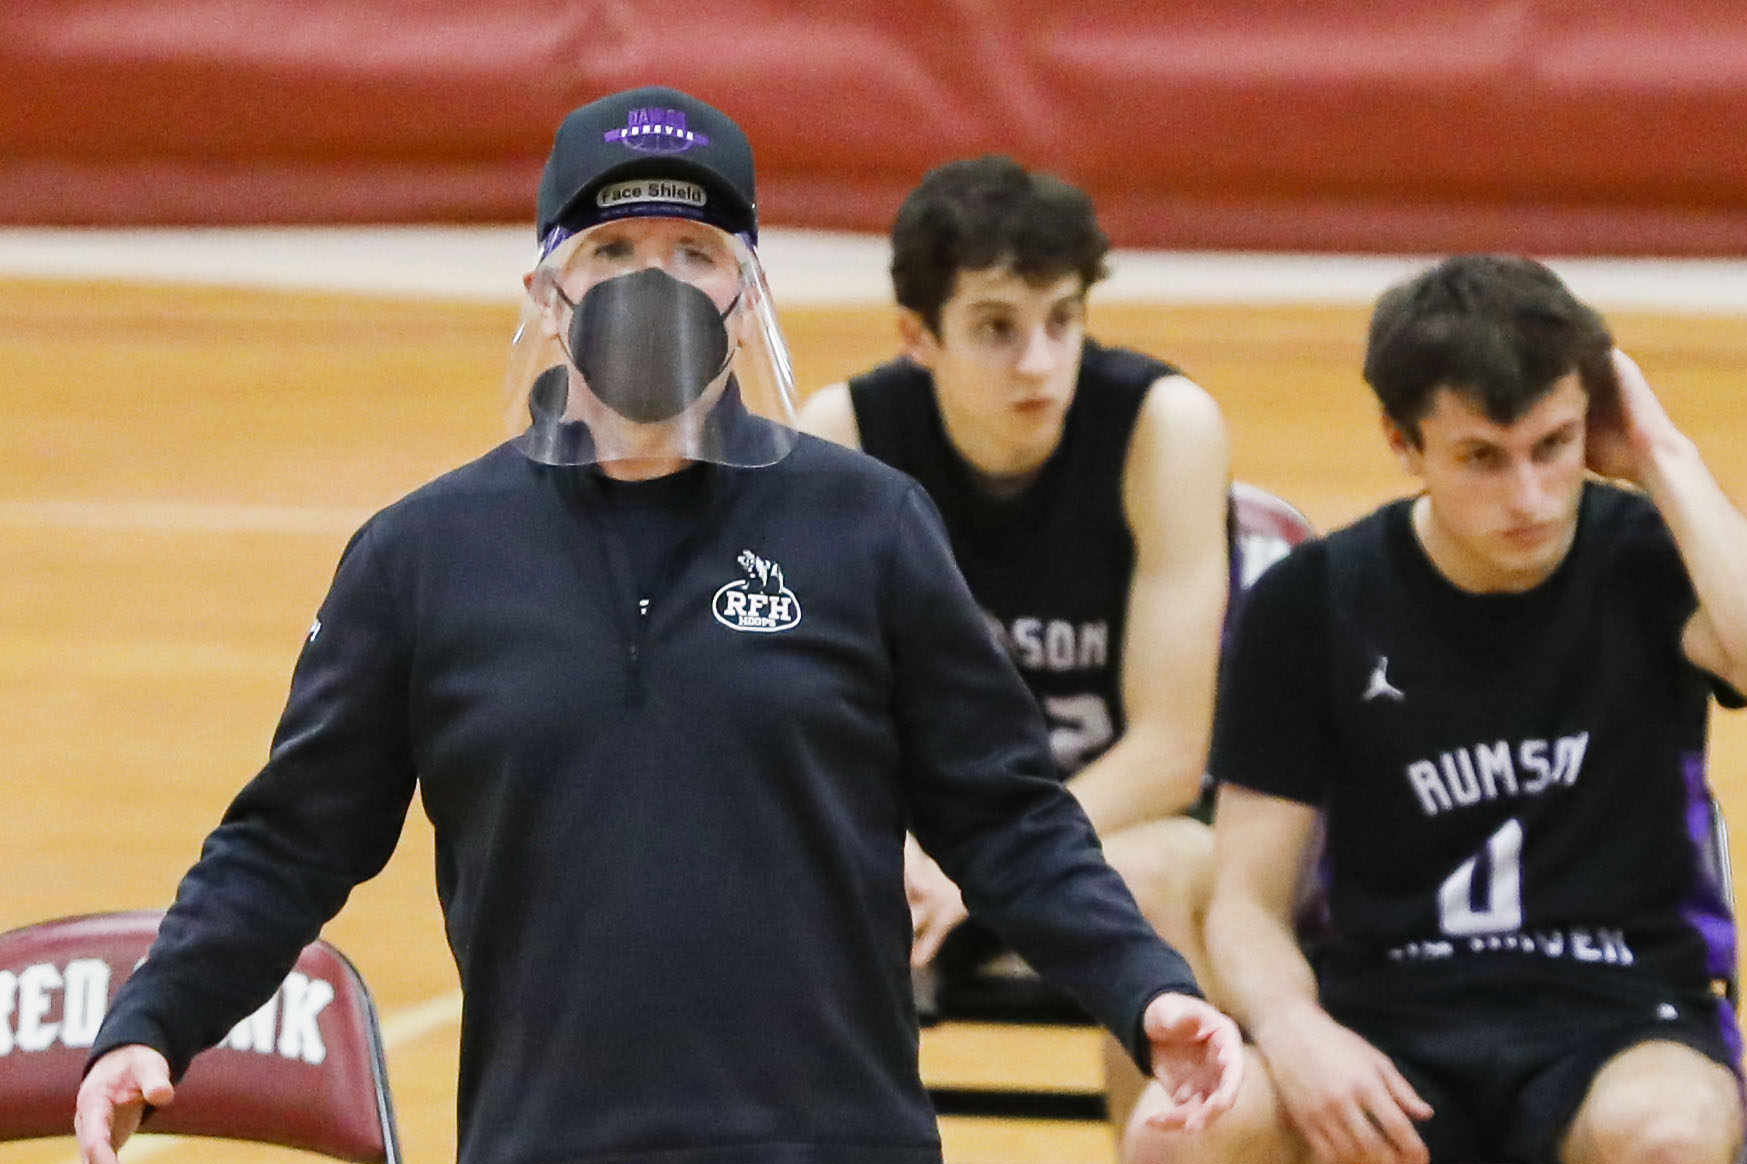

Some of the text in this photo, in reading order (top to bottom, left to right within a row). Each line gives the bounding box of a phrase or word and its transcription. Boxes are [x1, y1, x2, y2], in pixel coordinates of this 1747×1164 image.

[602, 183, 701, 203] Face Shield
[723, 590, 792, 621] RFH
[739, 616, 777, 627] HOOPS
[1407, 731, 1589, 816] RUMSN
